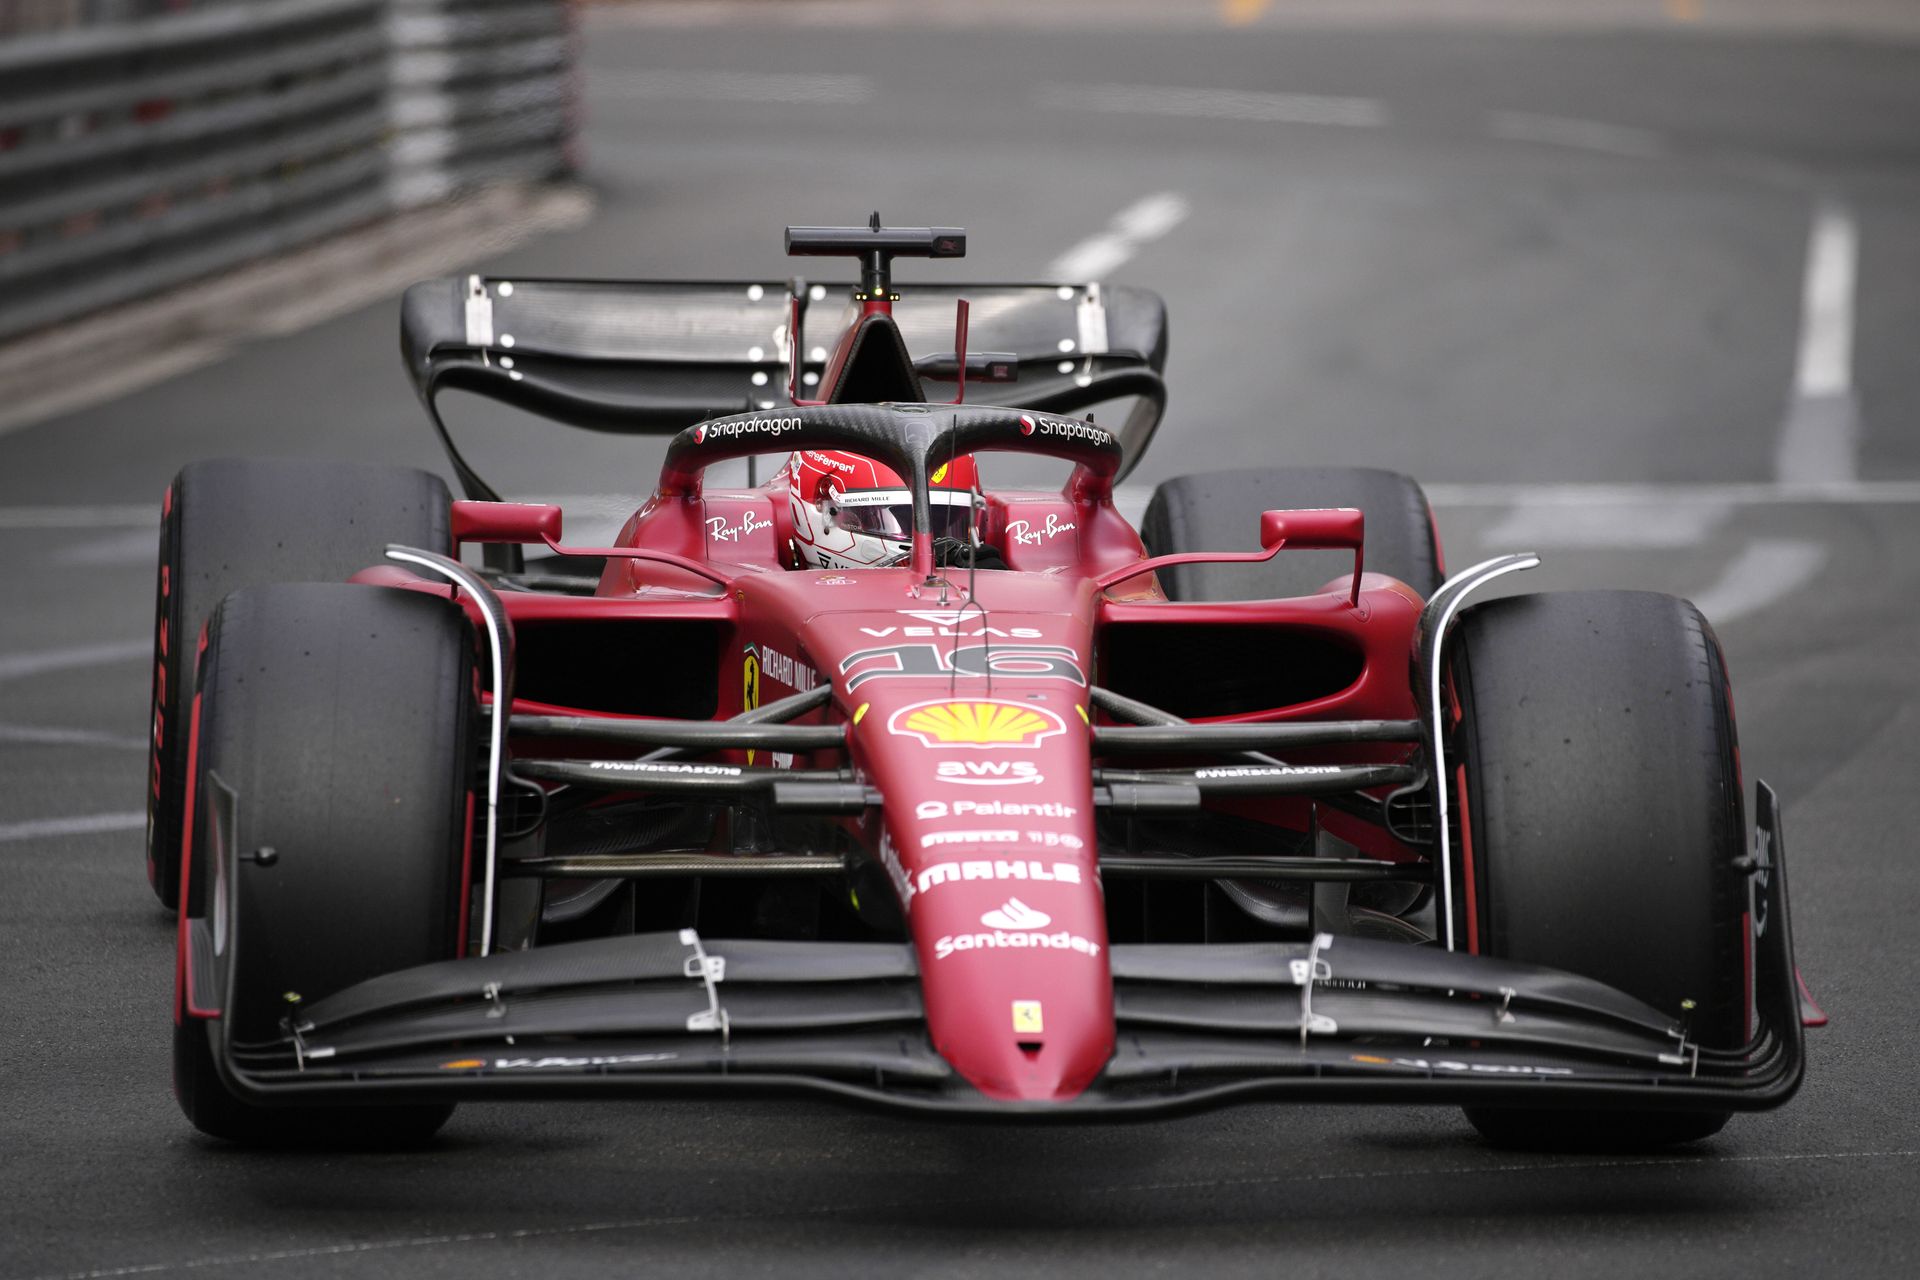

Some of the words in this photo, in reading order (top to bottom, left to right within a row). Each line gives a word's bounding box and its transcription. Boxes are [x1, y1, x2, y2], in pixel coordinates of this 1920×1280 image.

[709, 416, 802, 439] Snapdragon
[1038, 417, 1112, 446] Snapdragon
[705, 510, 773, 542] Ray-Ban
[1005, 513, 1076, 545] Ray-Ban
[859, 626, 1044, 638] VELAS
[762, 645, 793, 687] RICHARD
[838, 643, 1087, 695] 16
[936, 761, 1039, 777] aws
[952, 800, 1077, 818] Palantir
[917, 860, 1081, 893] MAHLE
[935, 930, 1101, 960] Santander
